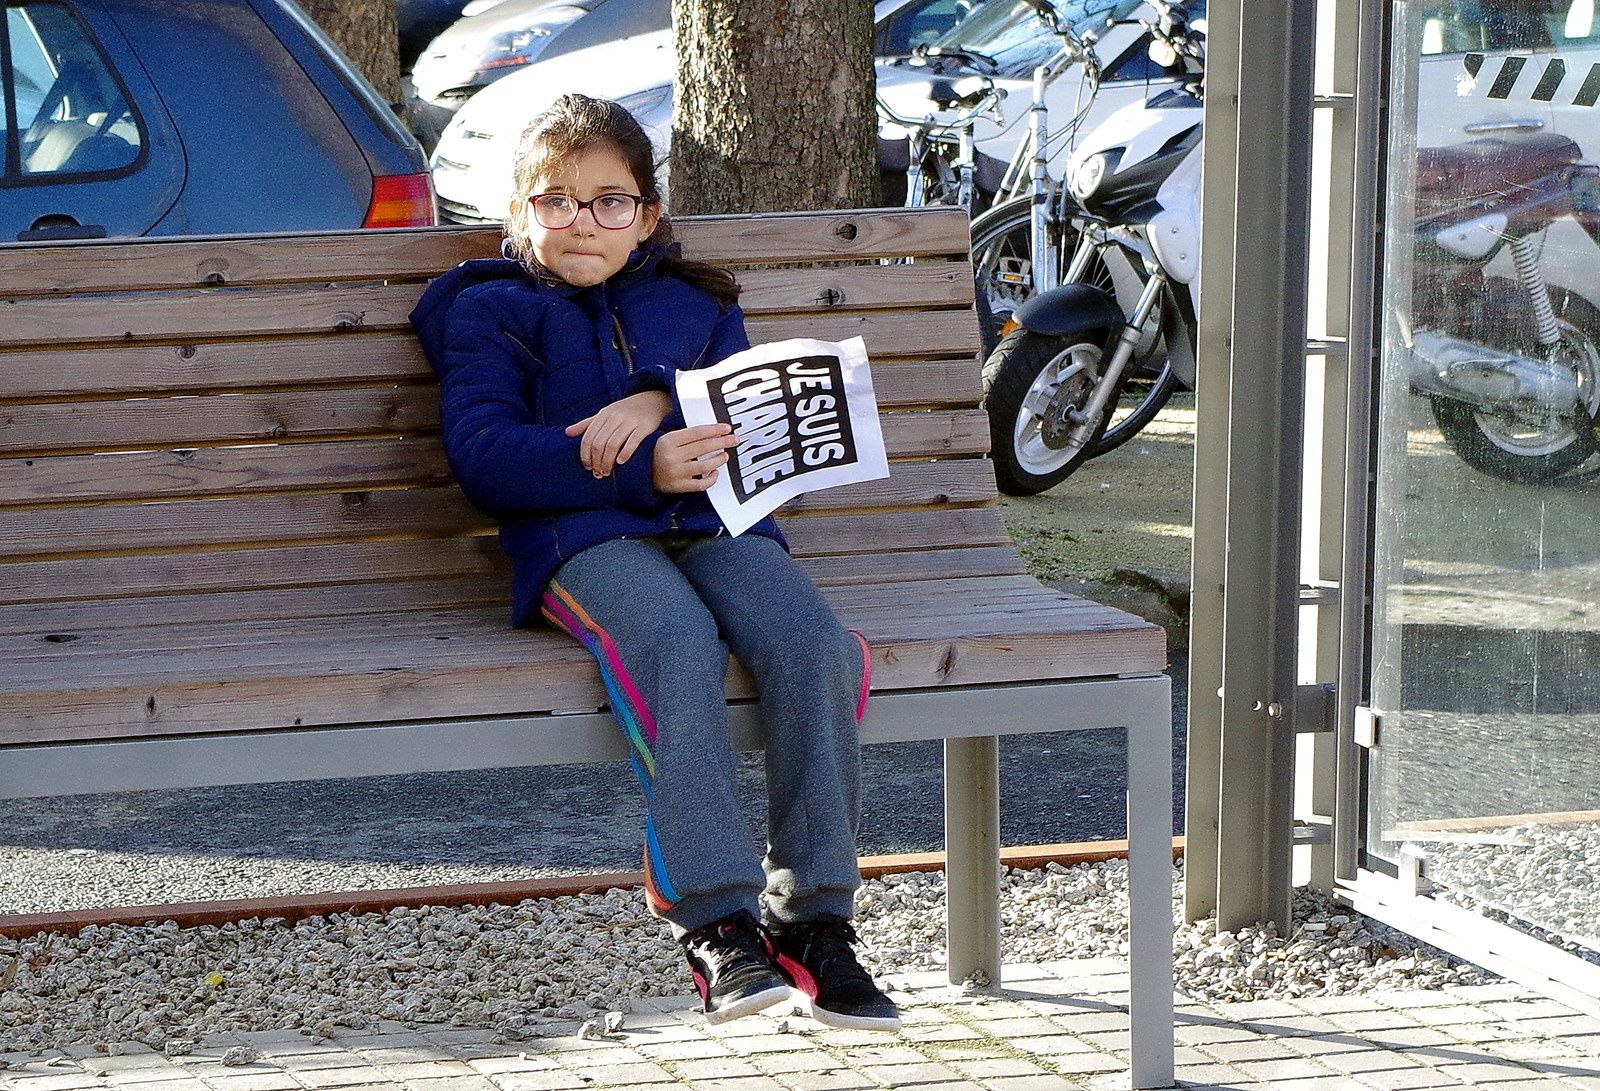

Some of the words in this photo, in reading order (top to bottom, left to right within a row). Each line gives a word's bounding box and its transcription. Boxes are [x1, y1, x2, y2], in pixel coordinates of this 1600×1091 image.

[786, 362, 832, 396] JE
[720, 368, 795, 494] CHARLIE
[796, 394, 845, 466] SUIS
